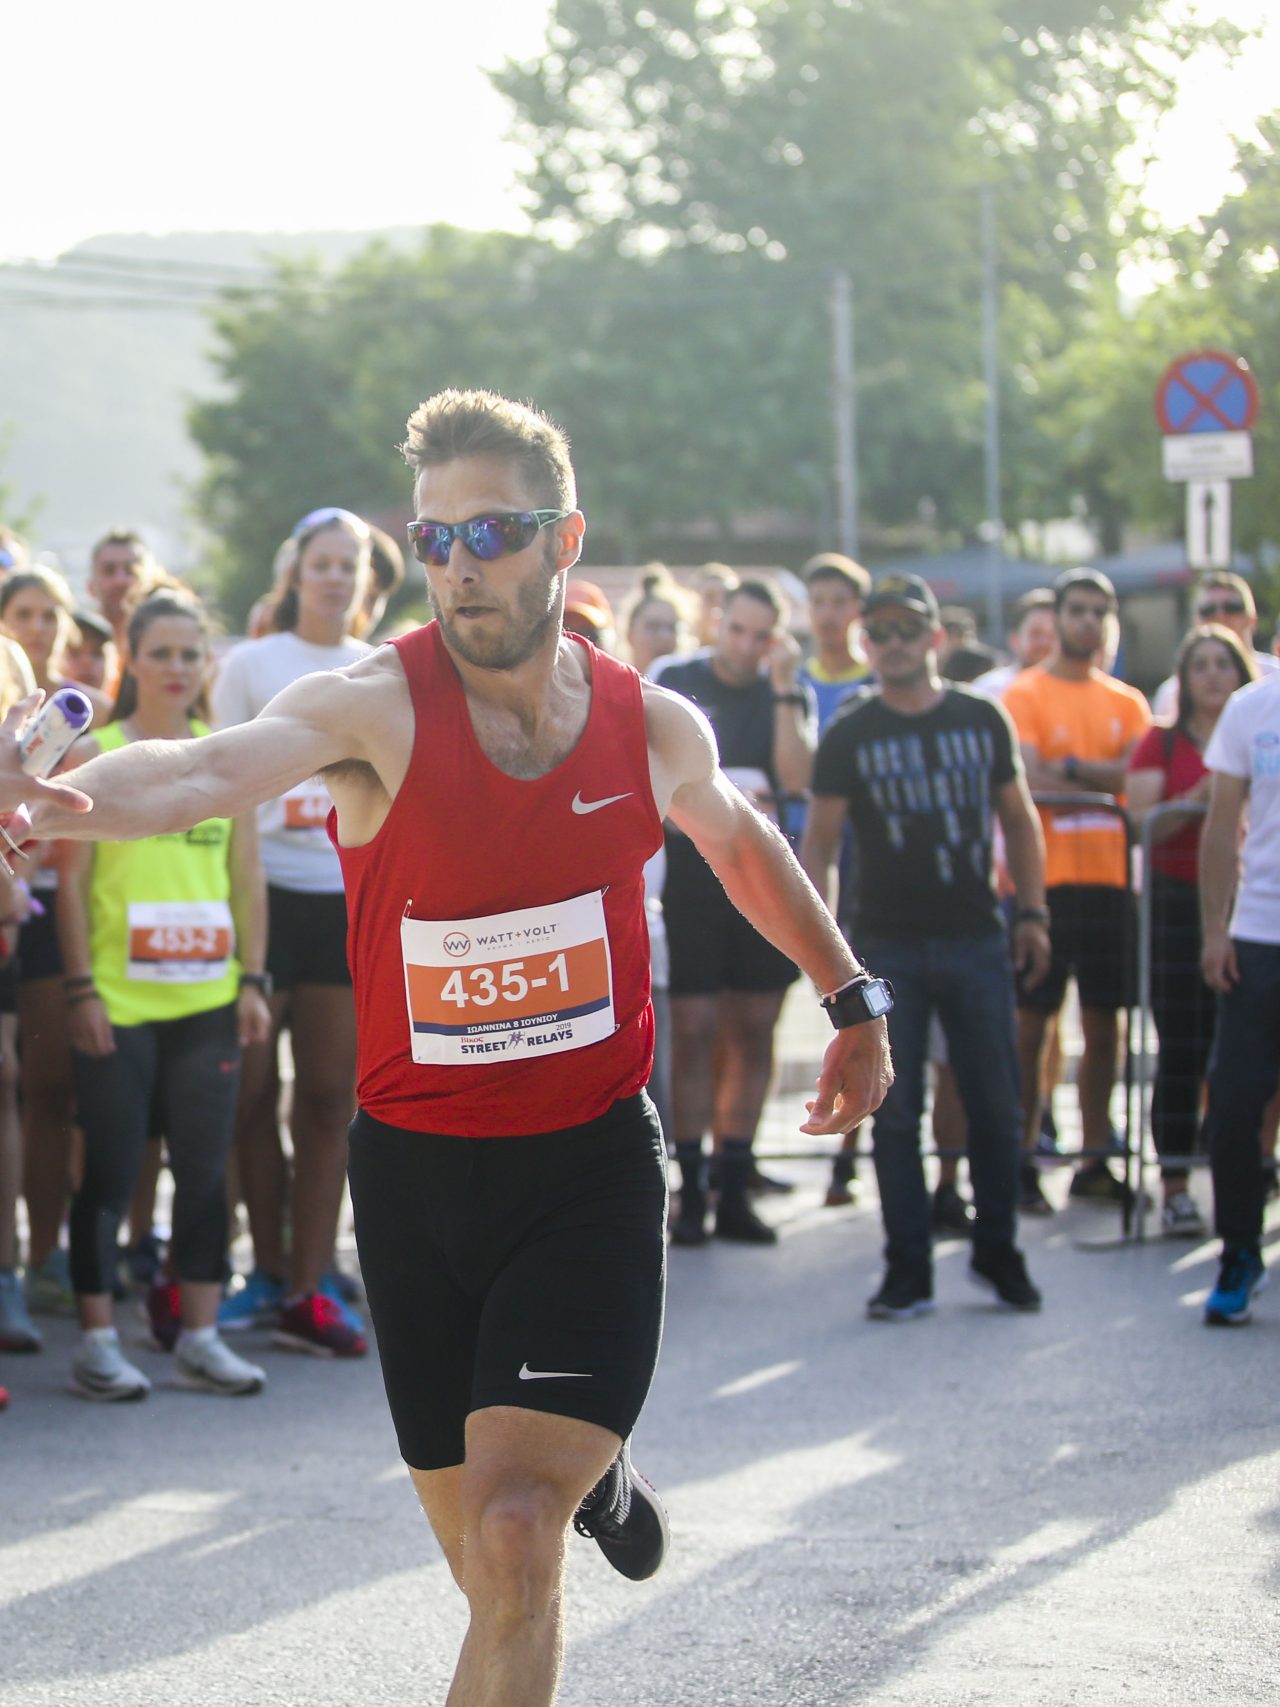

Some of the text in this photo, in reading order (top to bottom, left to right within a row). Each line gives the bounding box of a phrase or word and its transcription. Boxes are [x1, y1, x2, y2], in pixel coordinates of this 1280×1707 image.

[440, 953, 569, 1008] 435-1
[513, 1020, 519, 1028] 8
[556, 1021, 572, 1031] 2019
[461, 1029, 573, 1054] STREET RELAYS
